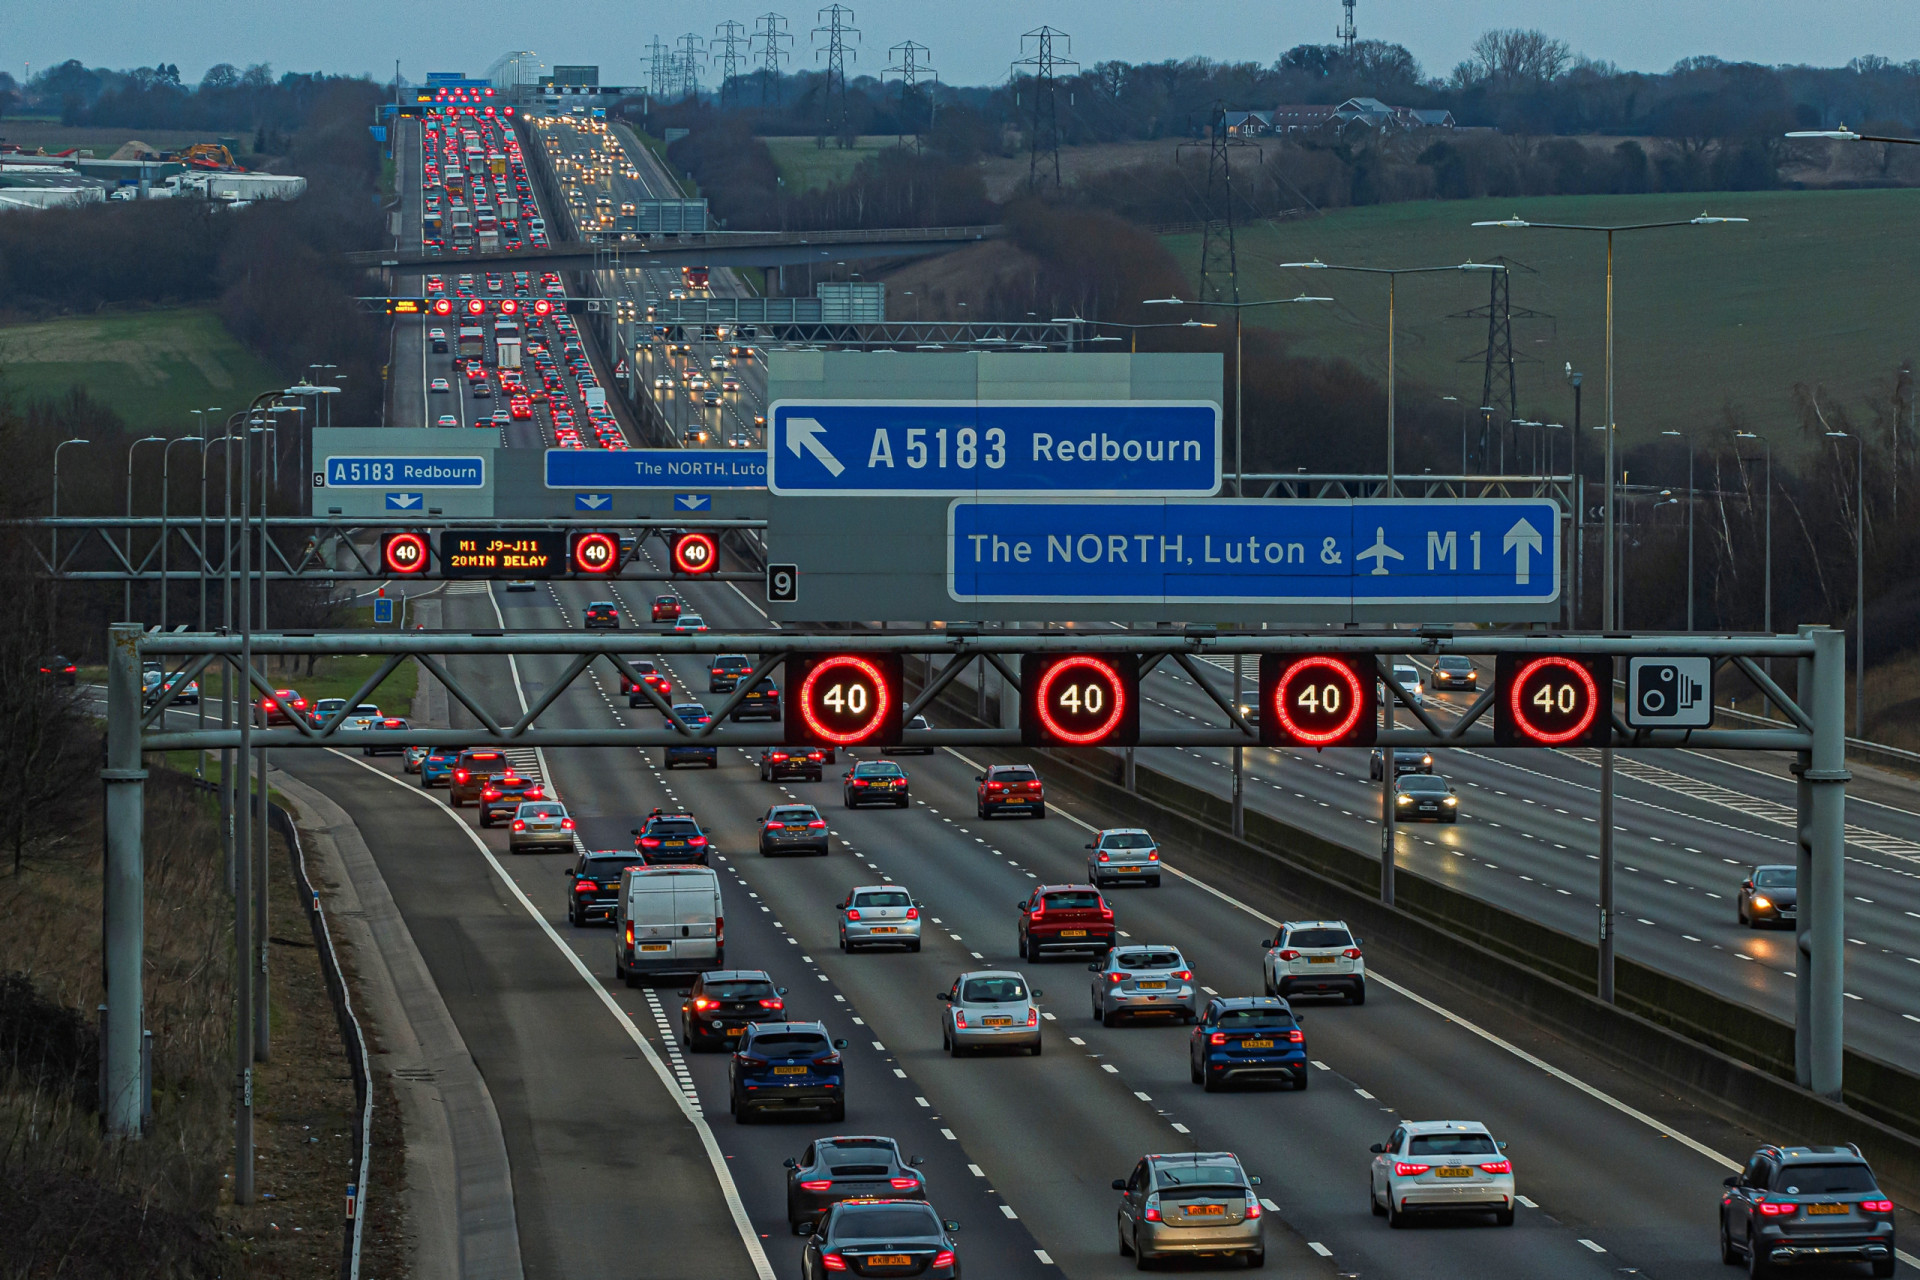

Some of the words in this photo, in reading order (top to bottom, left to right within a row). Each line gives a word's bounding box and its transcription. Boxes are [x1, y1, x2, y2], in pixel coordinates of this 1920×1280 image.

[1034, 432, 1201, 462] Redbourn
[404, 465, 476, 478] Redbourn
[635, 462, 662, 475] The
[732, 462, 766, 475] Luto
[316, 474, 323, 486] 9
[396, 545, 416, 560] 40
[460, 540, 477, 552] M1
[486, 540, 538, 552] J9-J11
[585, 545, 606, 560] 40
[685, 545, 706, 560] 40
[967, 534, 1032, 563] The
[1048, 534, 1193, 566] NORTH,
[1206, 535, 1304, 564] Luton
[1320, 536, 1342, 565] &
[1428, 531, 1481, 571] M1
[451, 555, 497, 567] 20MIN
[503, 555, 548, 567] DELAY
[775, 571, 791, 596] 9
[823, 683, 867, 714] 40
[1059, 684, 1103, 714] 40
[1297, 684, 1340, 714] 40
[1533, 684, 1576, 713] 40
[891, 1256, 907, 1264] JXL
